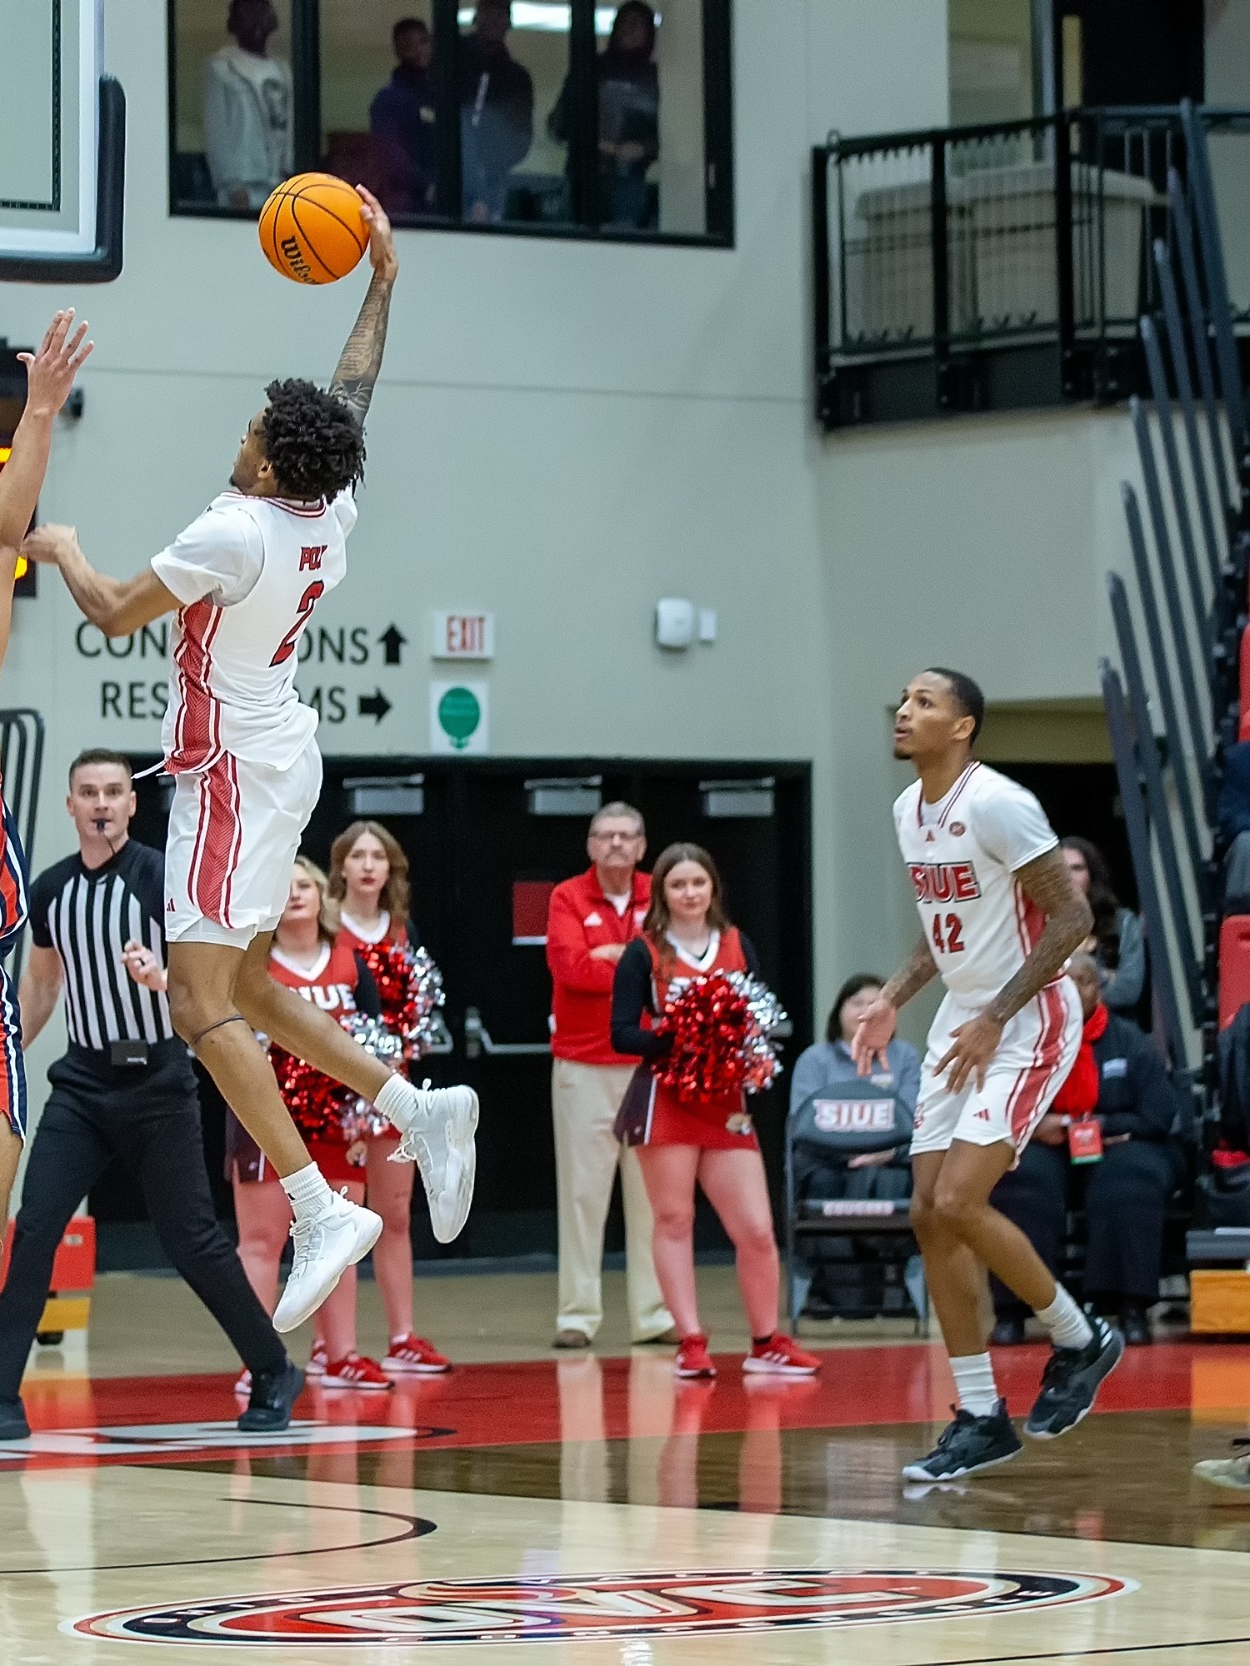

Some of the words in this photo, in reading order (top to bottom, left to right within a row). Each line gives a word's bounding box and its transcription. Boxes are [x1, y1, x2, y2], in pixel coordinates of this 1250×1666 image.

[269, 579, 325, 668] 2
[446, 615, 486, 652] EXIT
[932, 912, 965, 953] 42
[816, 1101, 892, 1129] SIUE
[297, 1578, 922, 1633] OVC
